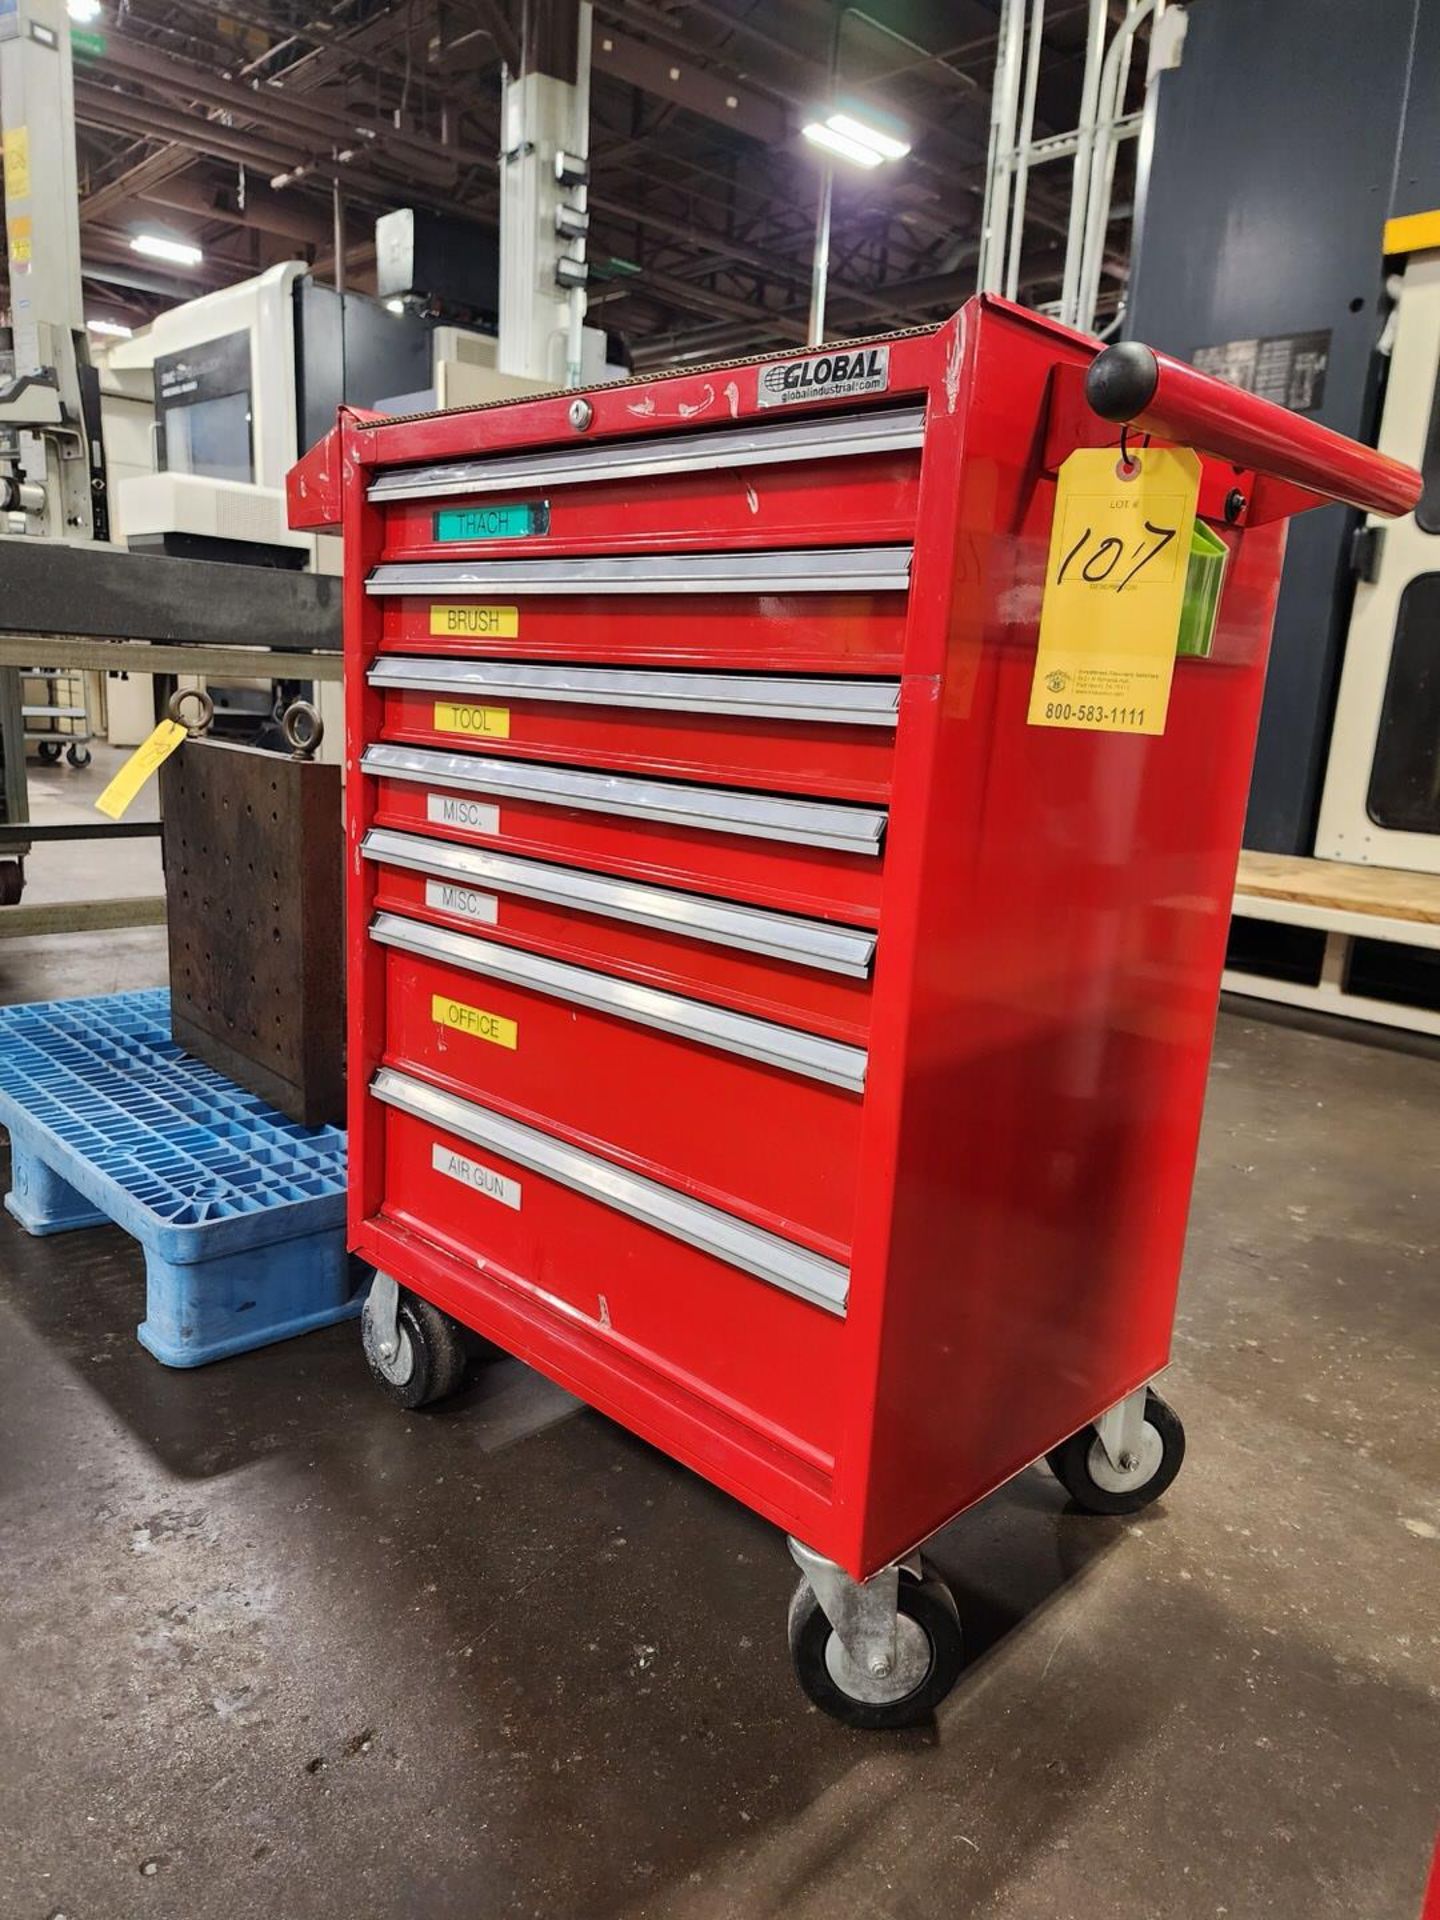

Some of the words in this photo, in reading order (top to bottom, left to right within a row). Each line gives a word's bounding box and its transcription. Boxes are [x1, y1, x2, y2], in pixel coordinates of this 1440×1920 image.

[784, 350, 882, 389] GLOBAL
[1110, 500, 1128, 508] LOT
[457, 511, 509, 534] THACH
[448, 609, 500, 631] BRUSH
[452, 707, 491, 731] TOOL
[1046, 703, 1144, 726] 800-583-1111
[443, 800, 482, 825] MISC.
[442, 887, 480, 915] MISC.
[448, 1004, 499, 1038] OFFICE
[448, 1156, 470, 1180] AIR
[474, 1167, 504, 1196] GUN
